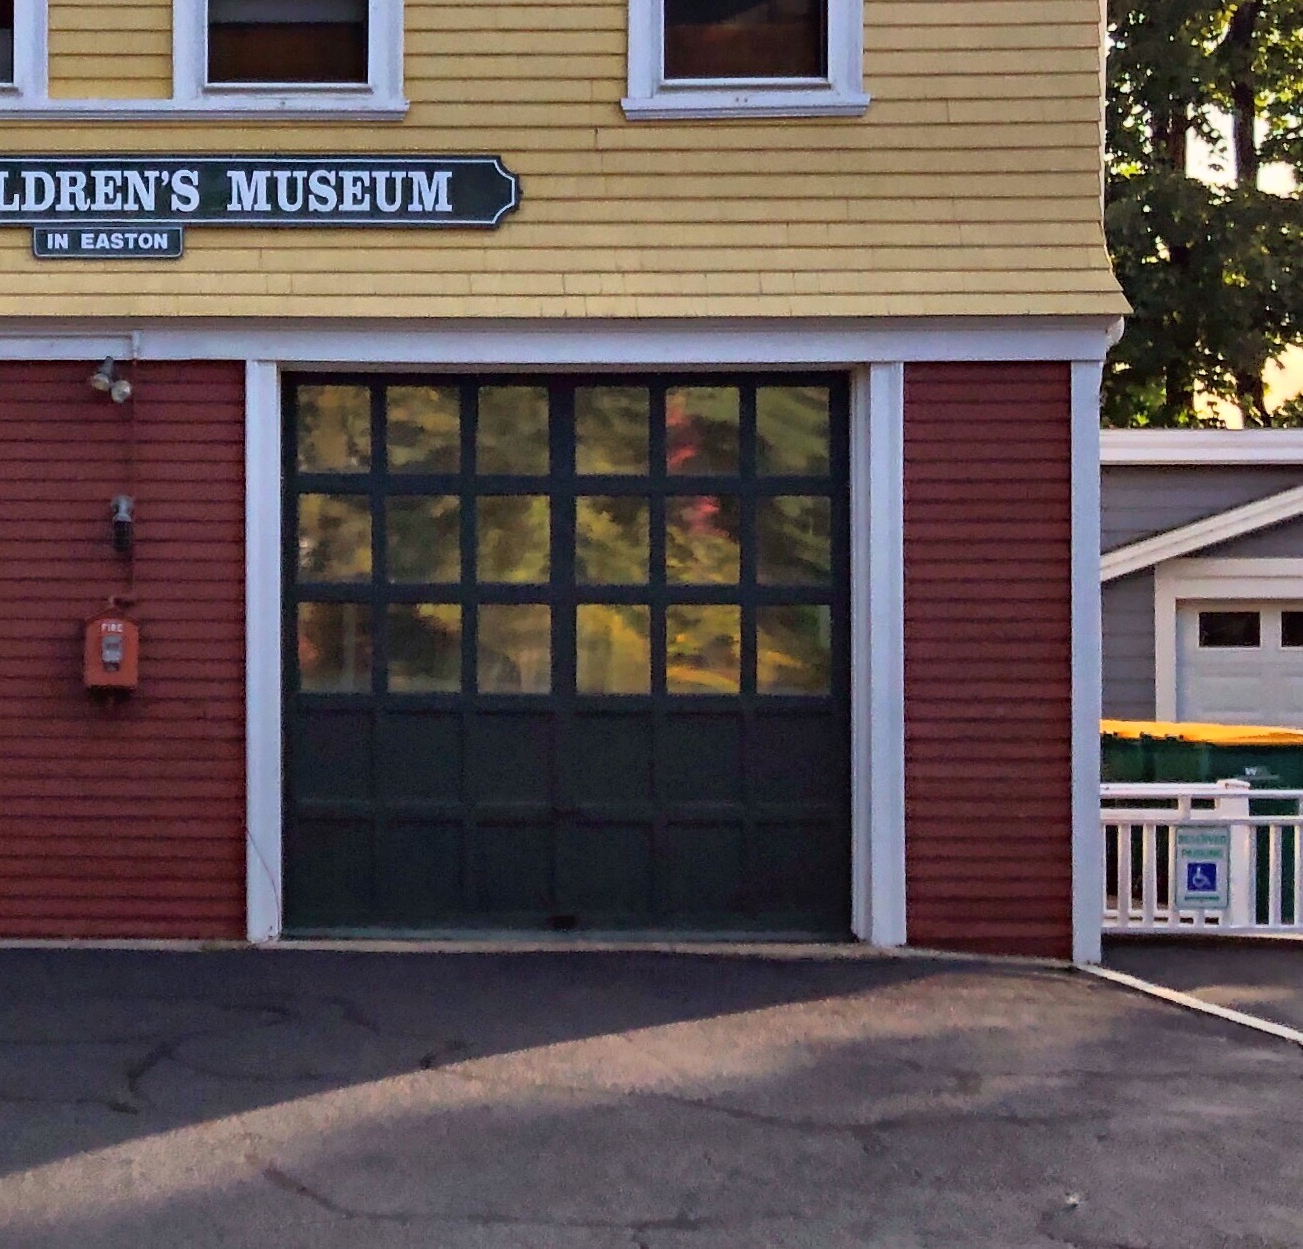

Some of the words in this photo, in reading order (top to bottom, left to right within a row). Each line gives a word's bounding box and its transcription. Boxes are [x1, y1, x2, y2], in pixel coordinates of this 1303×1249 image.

[226, 170, 453, 212] MUSEUM
[47, 234, 69, 249] IN
[81, 234, 168, 249] EASTON
[101, 623, 123, 632] FIRE
